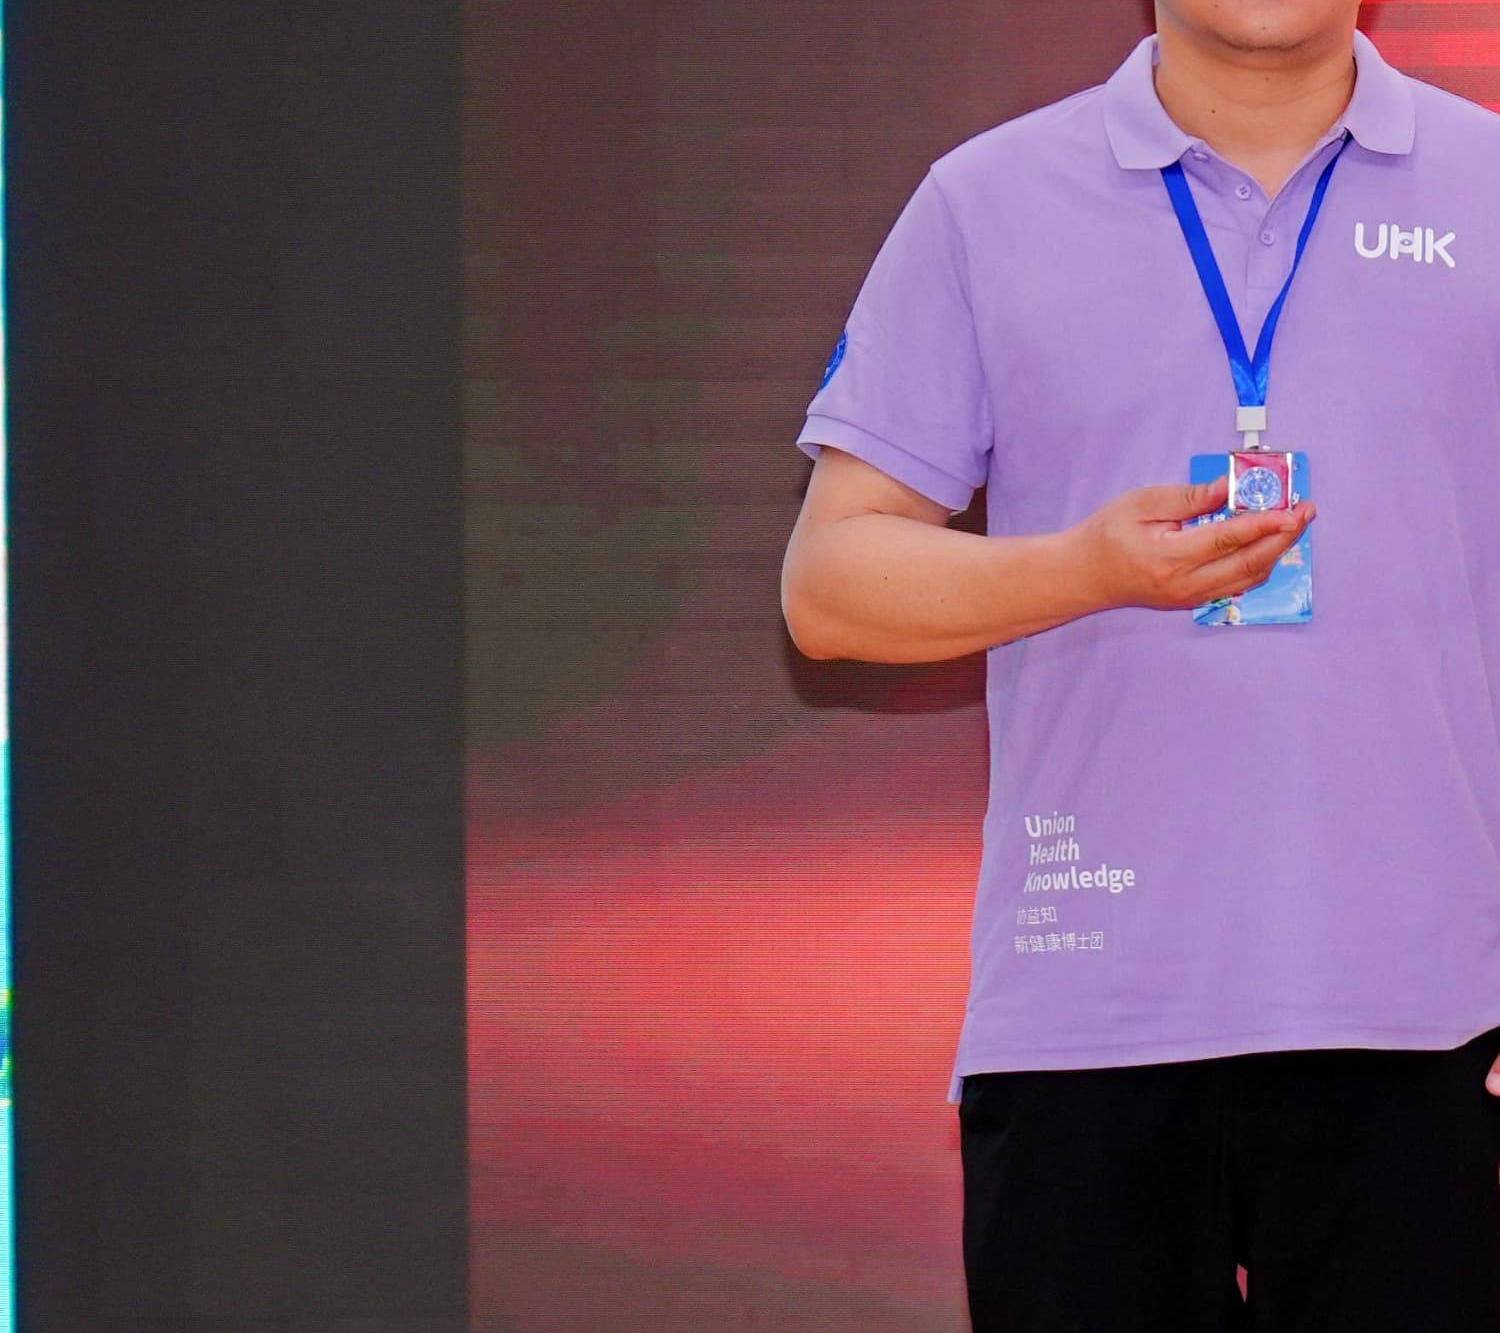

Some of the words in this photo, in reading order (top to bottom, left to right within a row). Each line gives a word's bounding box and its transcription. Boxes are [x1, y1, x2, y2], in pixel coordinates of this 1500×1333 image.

[1354, 222, 1456, 268] UHK
[1024, 811, 1075, 837] Union
[1030, 837, 1080, 865] Health
[1024, 863, 1136, 893] Knowledge
